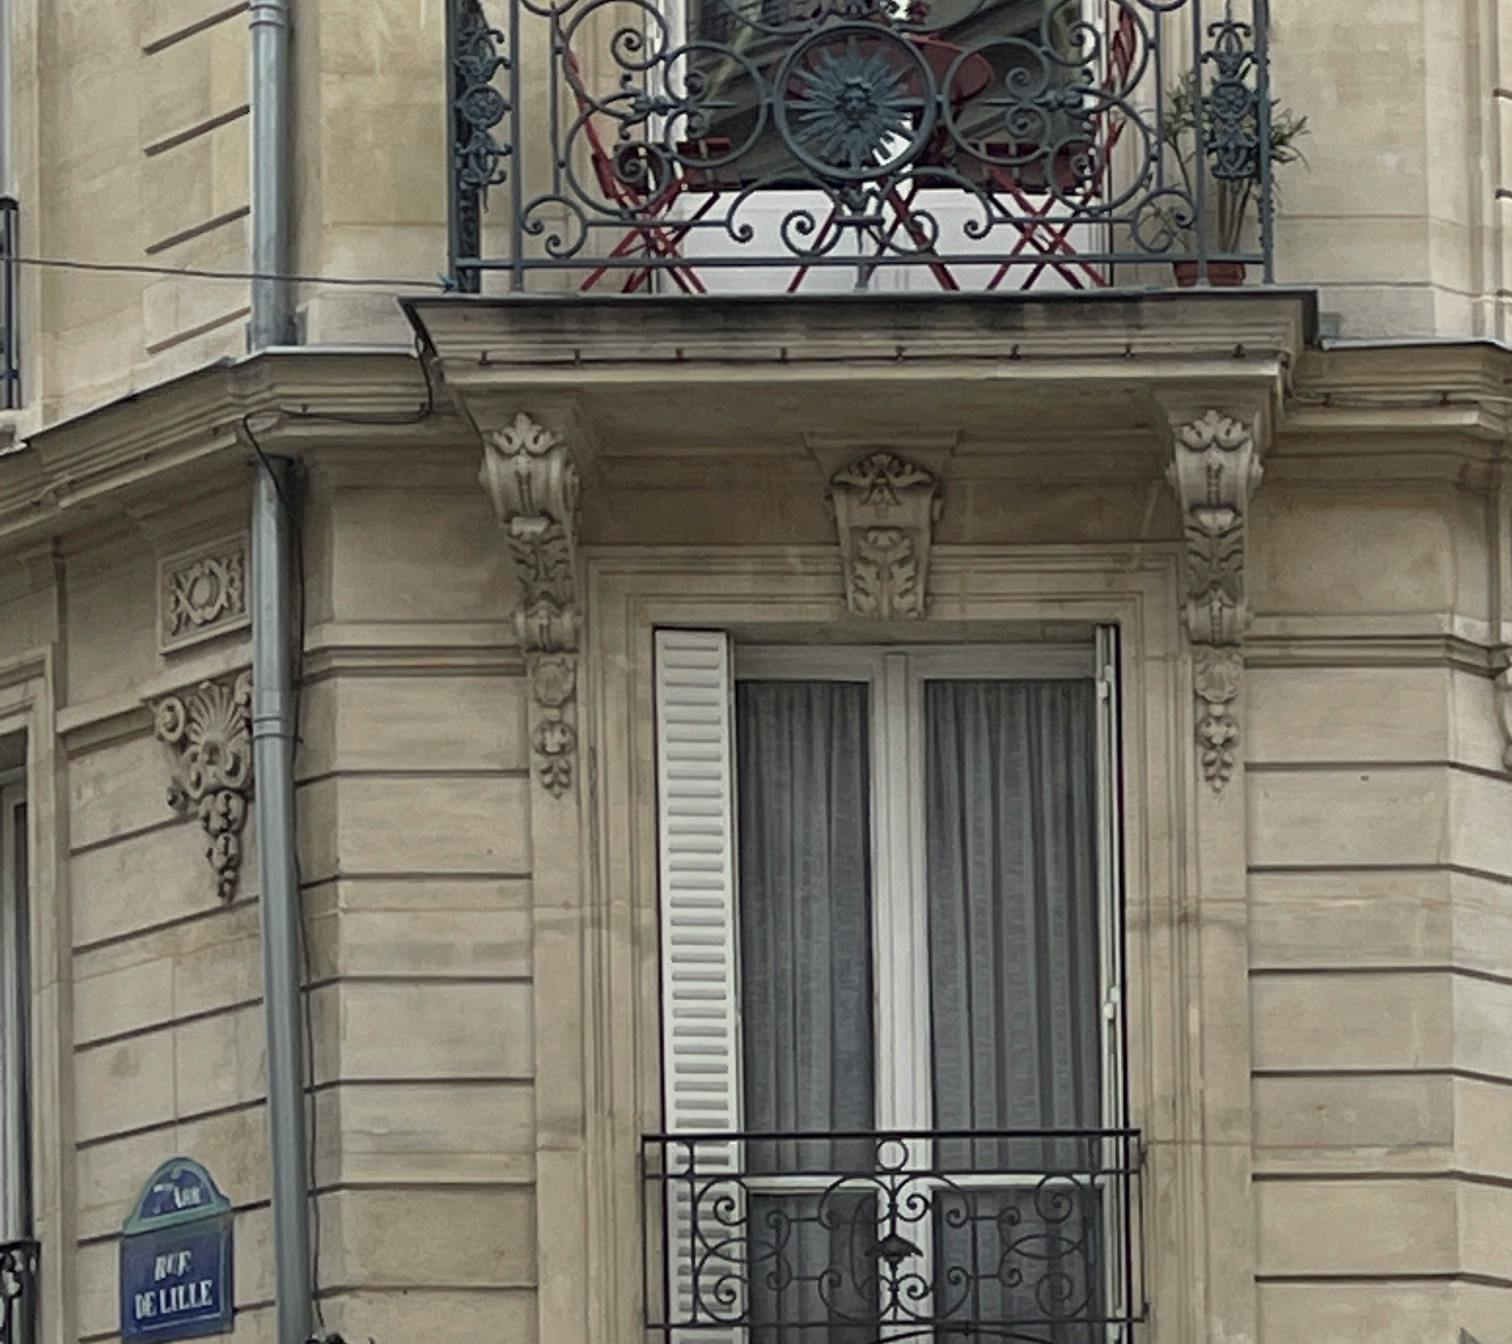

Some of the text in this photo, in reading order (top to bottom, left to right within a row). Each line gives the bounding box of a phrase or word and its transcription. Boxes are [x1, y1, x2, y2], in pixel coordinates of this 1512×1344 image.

[154, 1250, 192, 1281] RUE
[134, 1279, 213, 1320] DE LILLE
